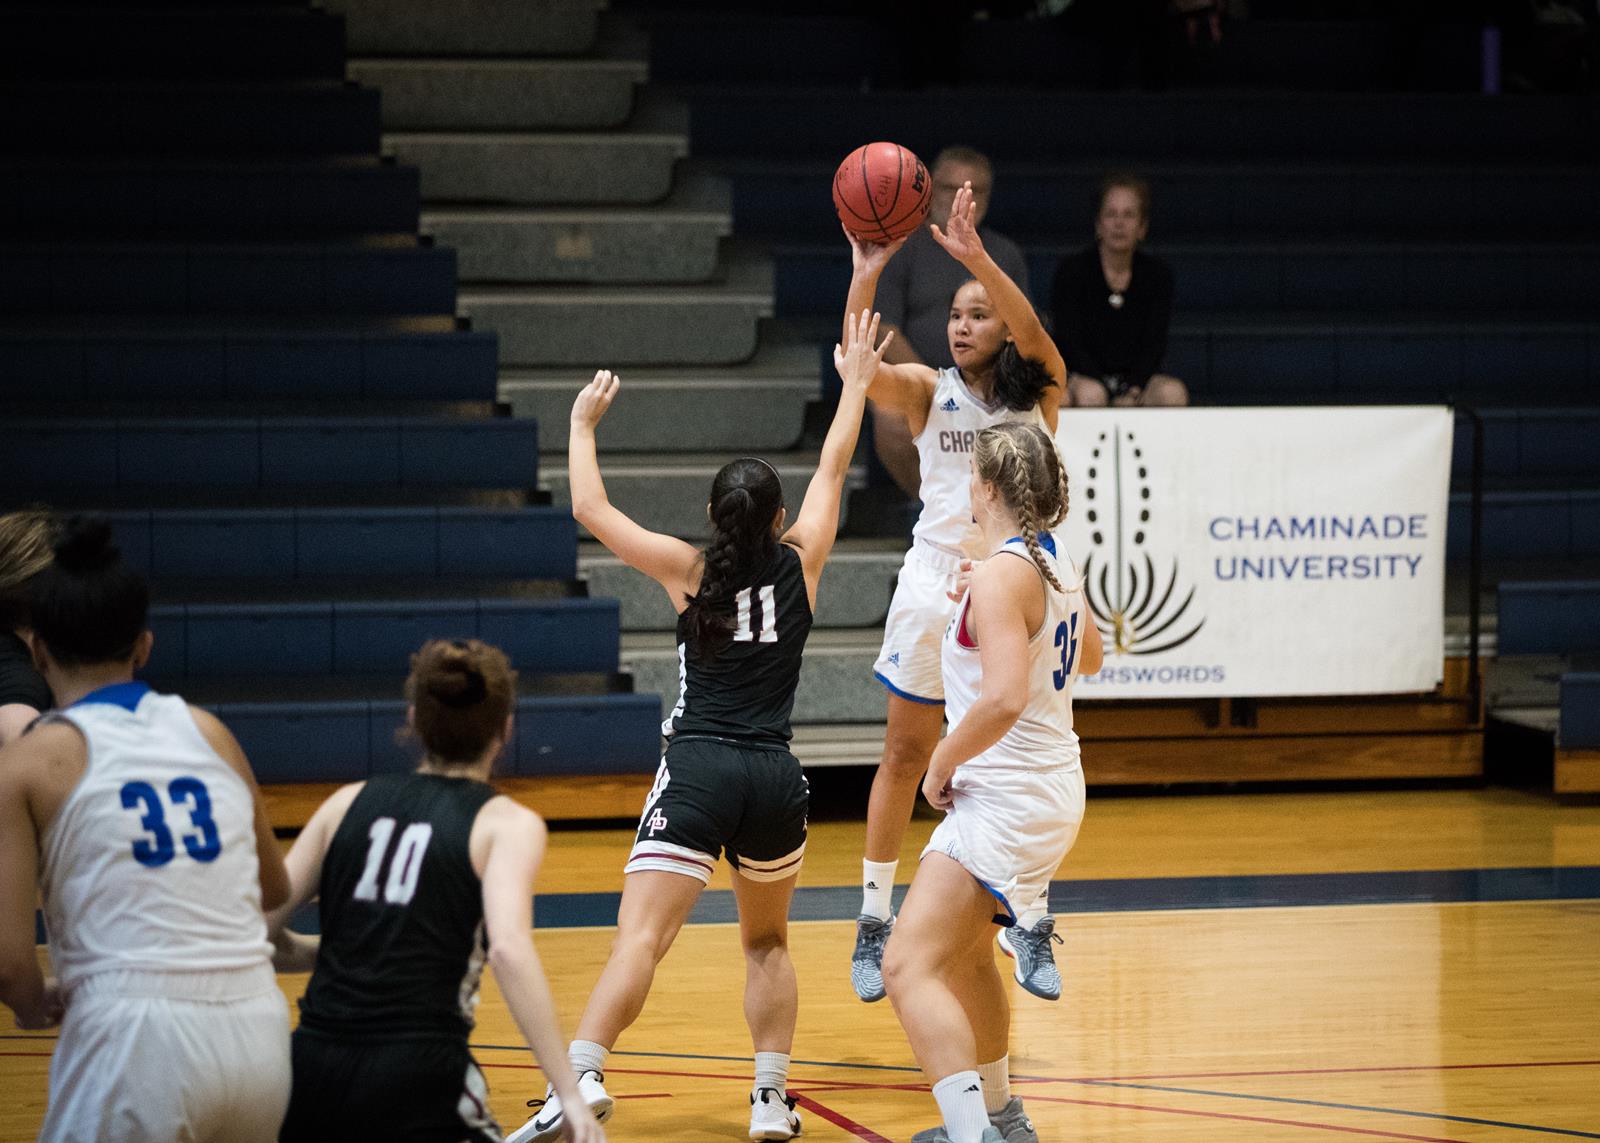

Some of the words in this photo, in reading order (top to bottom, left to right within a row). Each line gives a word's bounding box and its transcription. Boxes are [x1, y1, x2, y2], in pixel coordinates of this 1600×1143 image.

[1209, 514, 1428, 541] CHAMINADE
[1214, 555, 1422, 580] UNIVERSITY
[733, 584, 778, 642] 11
[1075, 664, 1225, 685] RSWORDS
[120, 776, 222, 867] 33
[353, 816, 433, 904] 10
